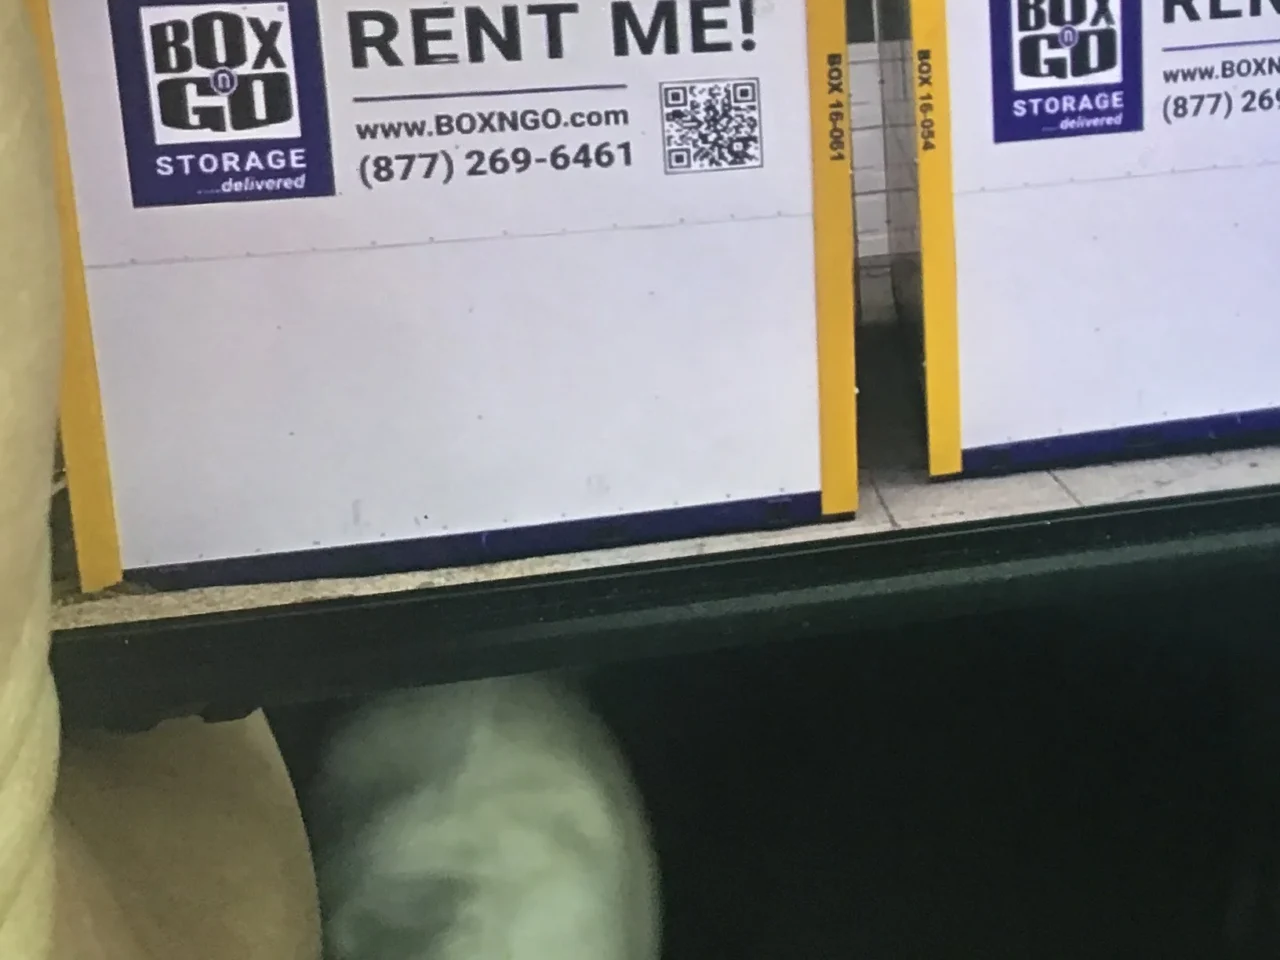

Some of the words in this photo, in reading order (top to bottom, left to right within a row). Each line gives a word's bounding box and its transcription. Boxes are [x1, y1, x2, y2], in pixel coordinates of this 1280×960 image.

[150, 10, 287, 74] BOX
[347, 2, 579, 69] RENT
[1018, 27, 1117, 79] GO
[827, 53, 843, 94] BOX
[917, 49, 932, 87] BOX
[157, 71, 293, 132] GO
[356, 107, 629, 140] www.BOXNGO.com
[918, 93, 936, 151] 16-054
[1012, 90, 1125, 117] STORAGE
[1162, 91, 1233, 124] (877)
[156, 148, 307, 176] STORAGE
[358, 150, 454, 189] (877)
[465, 141, 633, 177] 269-6461
